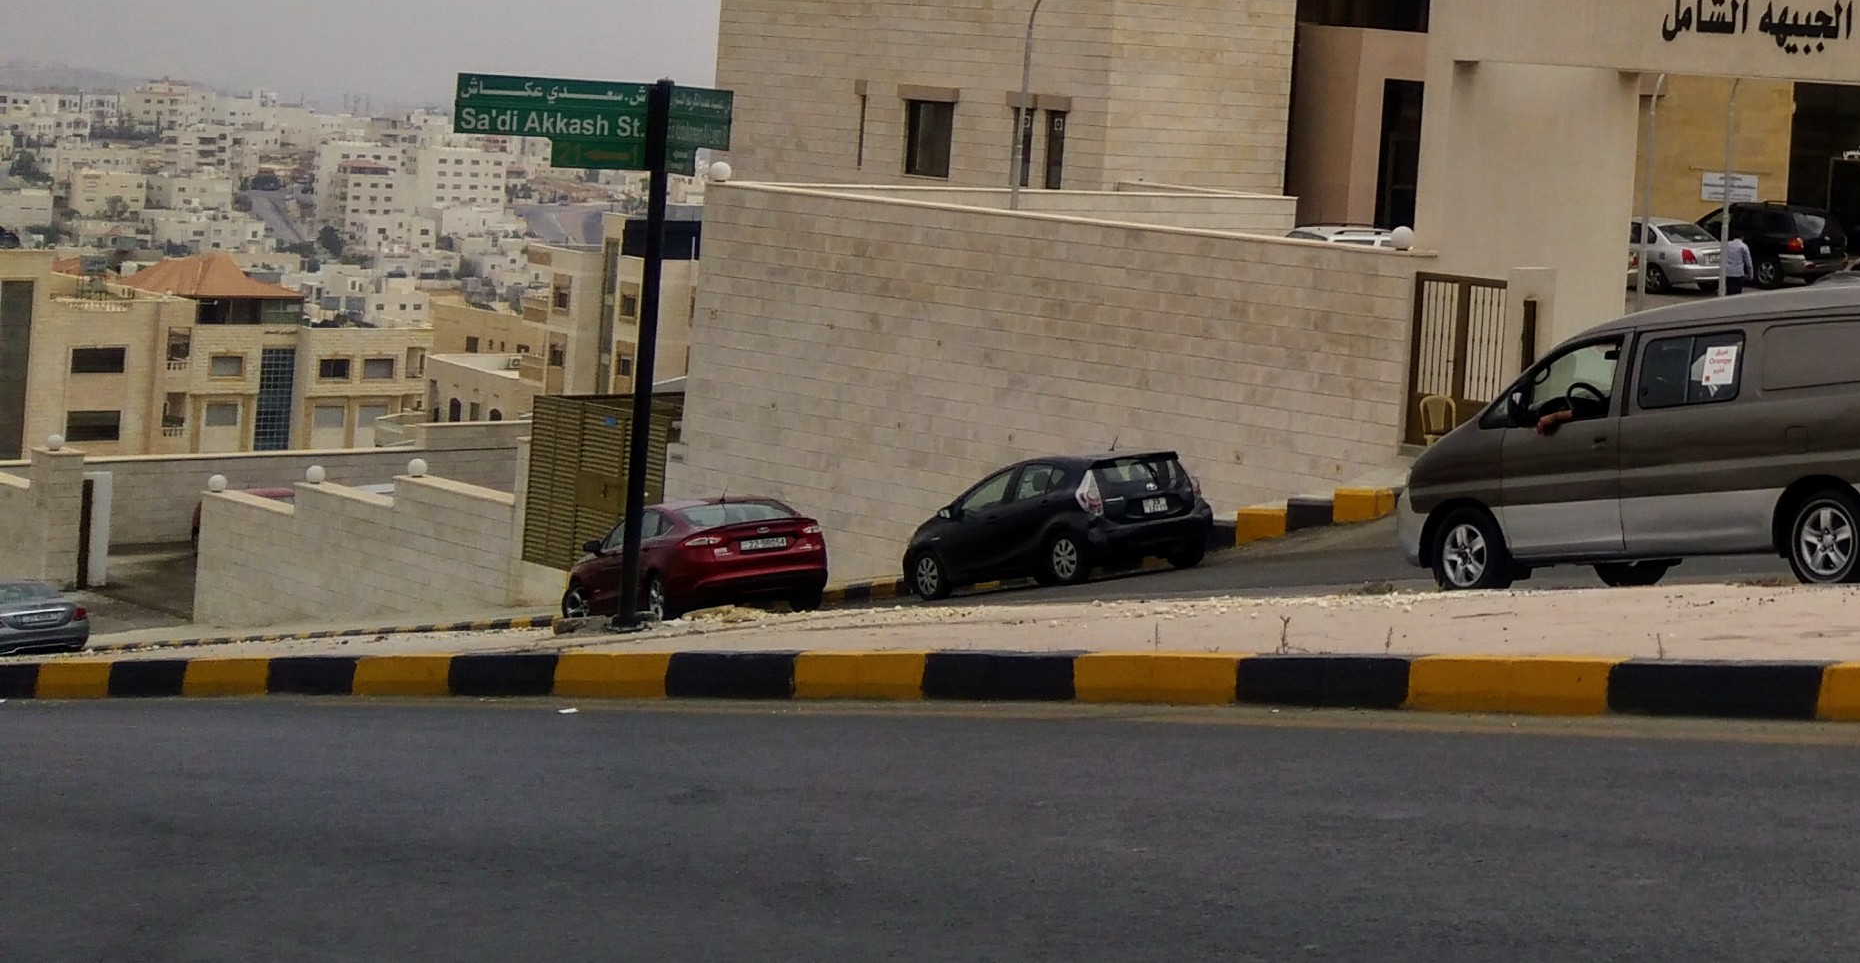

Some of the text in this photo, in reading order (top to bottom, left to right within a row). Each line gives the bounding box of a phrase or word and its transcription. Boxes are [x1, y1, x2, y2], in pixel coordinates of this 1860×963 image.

[460, 77, 544, 98] عكاش
[460, 107, 518, 132] Sa'di
[523, 111, 609, 137] Akkash
[616, 116, 646, 138] St.
